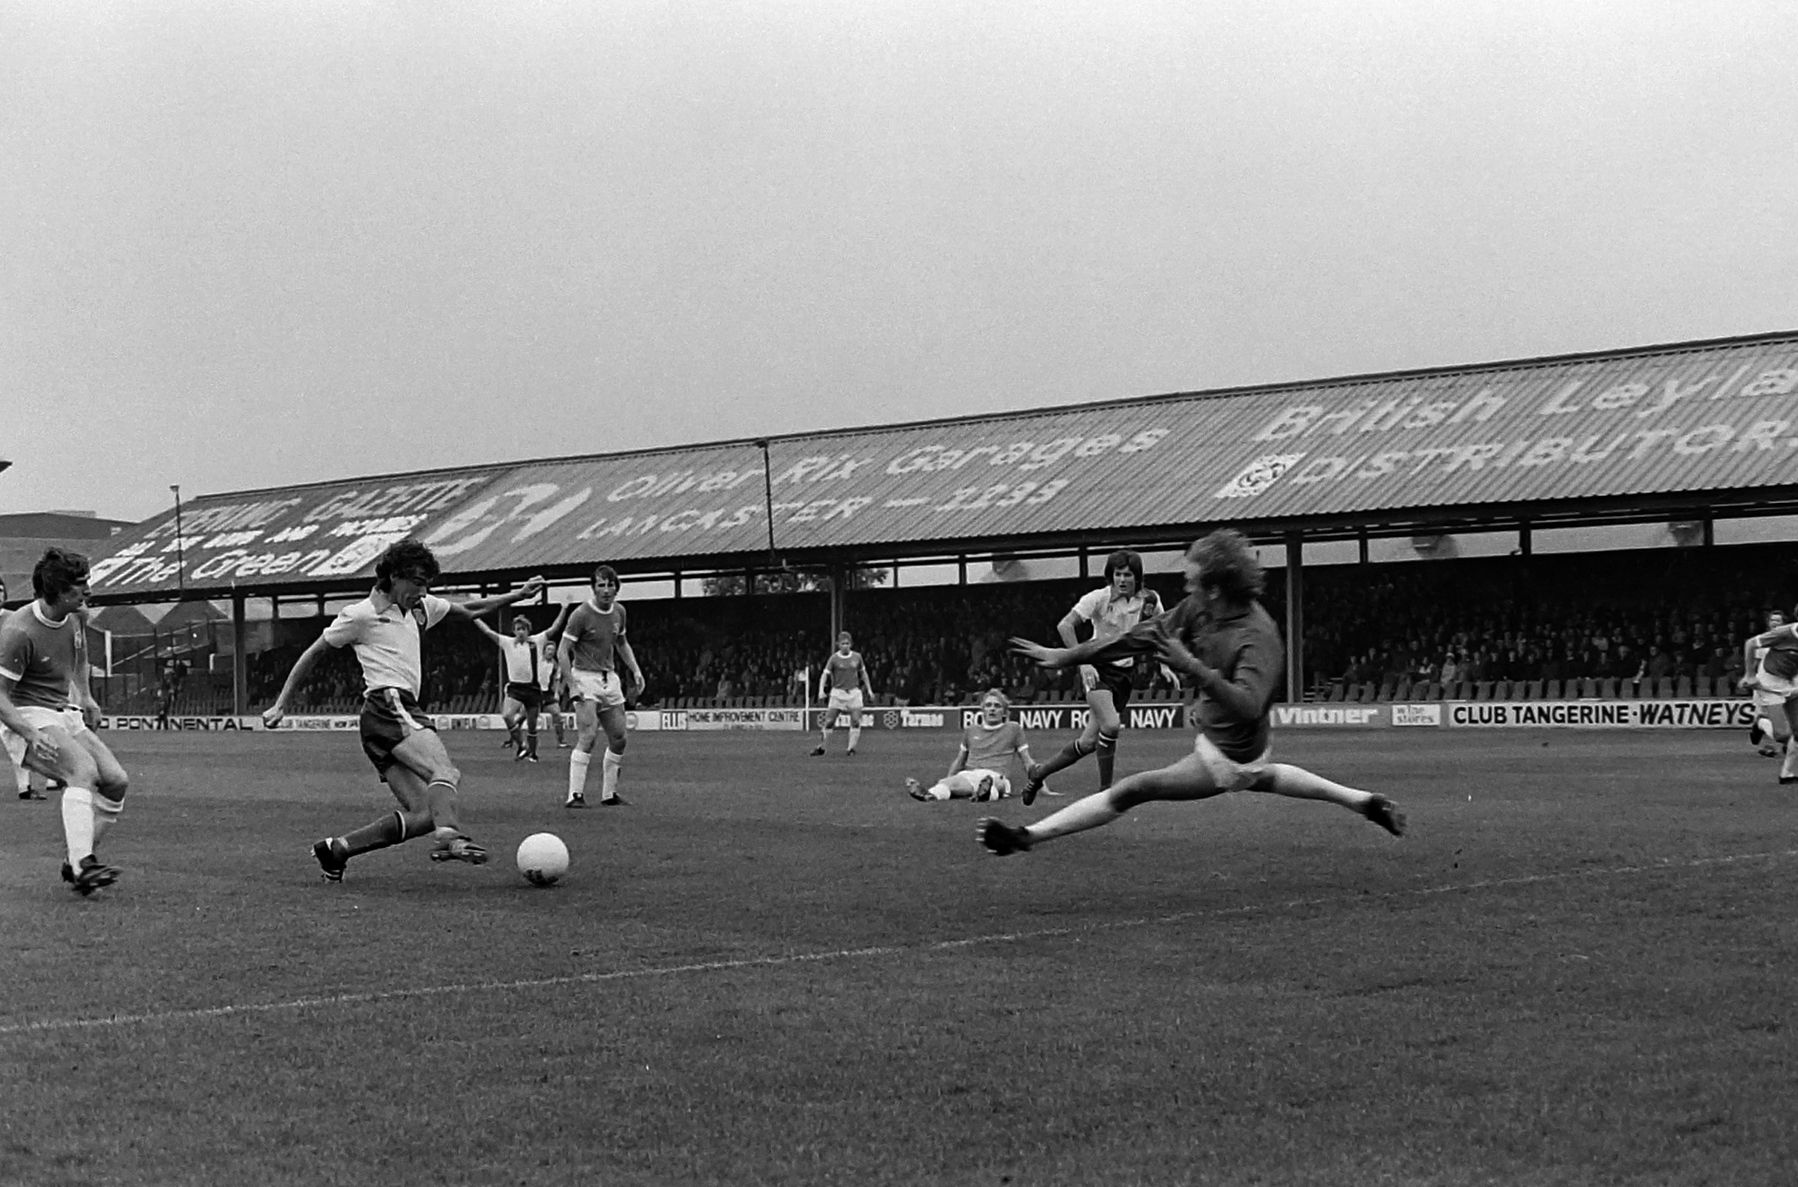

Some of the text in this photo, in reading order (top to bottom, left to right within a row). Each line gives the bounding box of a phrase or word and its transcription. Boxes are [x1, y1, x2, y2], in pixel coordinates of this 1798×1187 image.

[607, 428, 1170, 502] Oliver Rix Garages
[576, 496, 874, 540] LANCASTER
[105, 549, 331, 587] The Green
[1019, 709, 1063, 729] NAVY
[1130, 708, 1177, 729] NAVY
[1277, 706, 1378, 725] Vintner
[1453, 702, 1756, 725] CLUB TANGERINE WATNEYS
